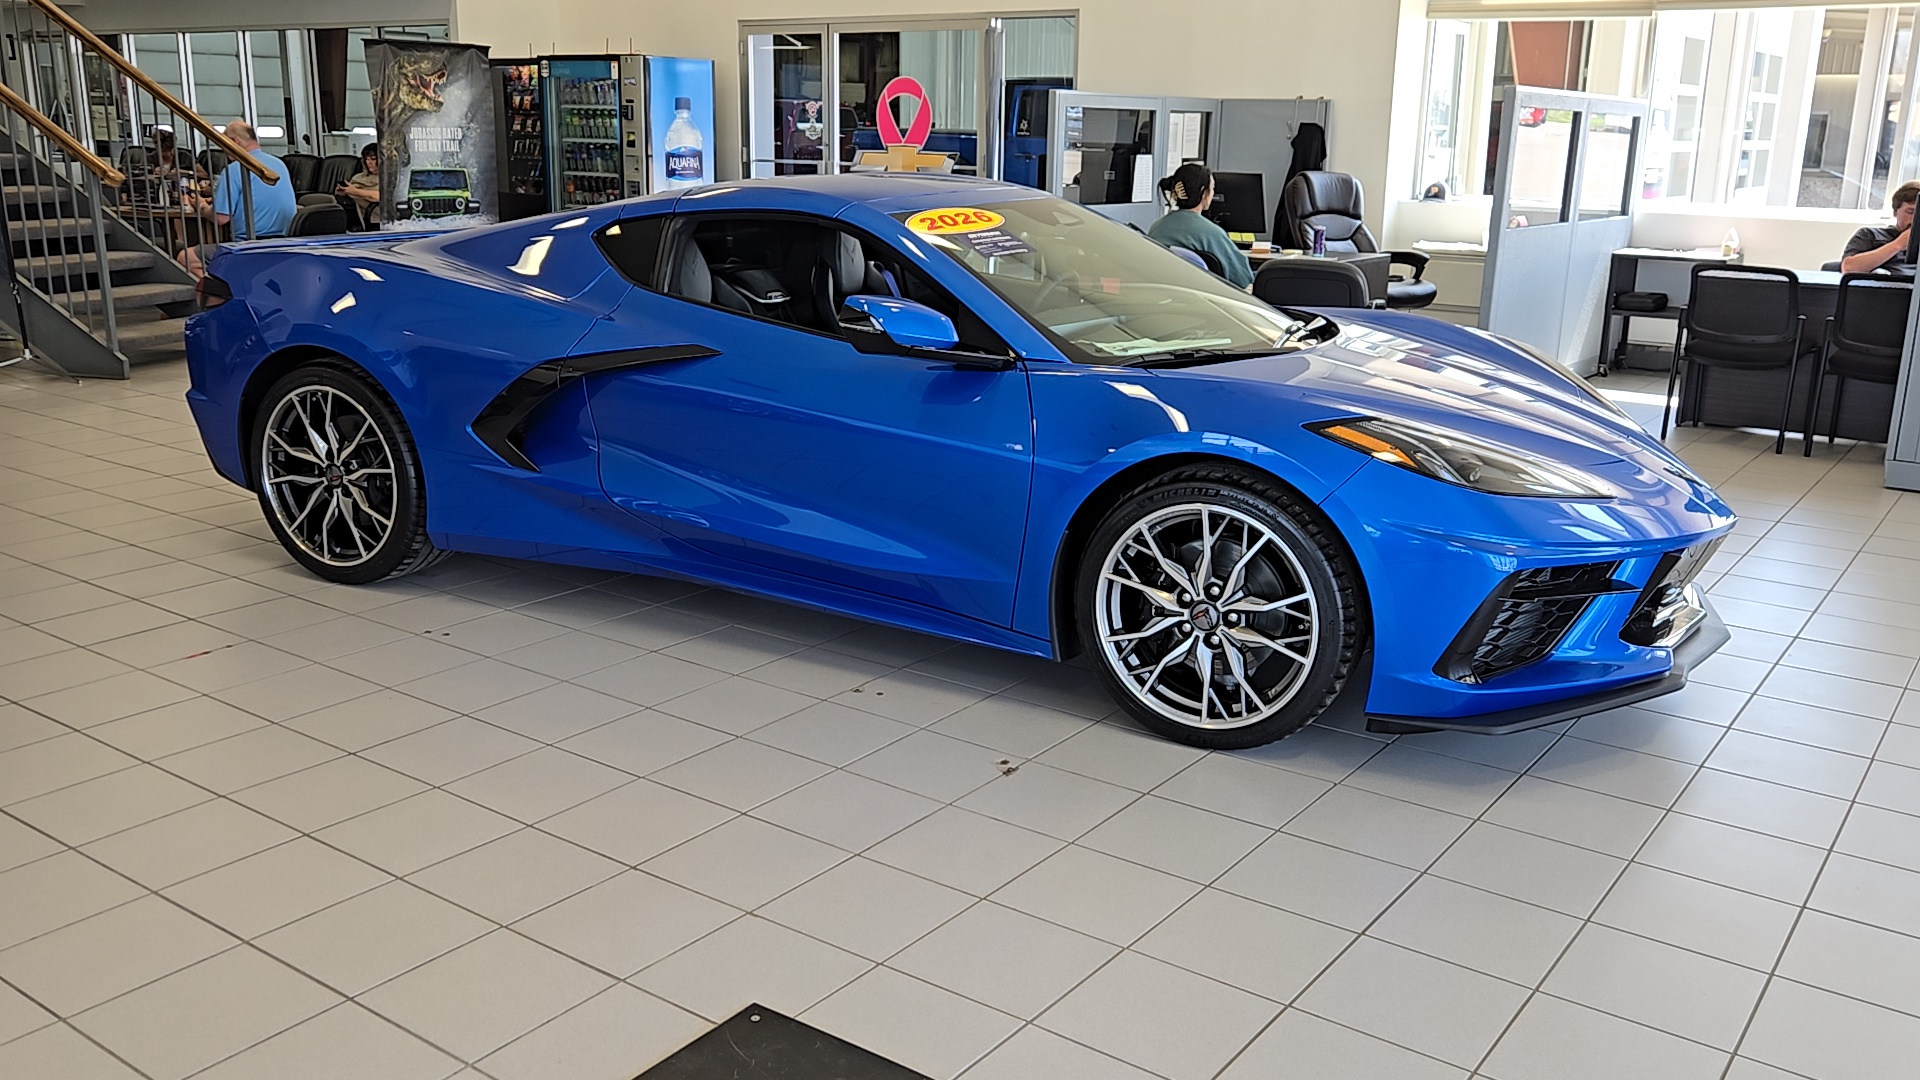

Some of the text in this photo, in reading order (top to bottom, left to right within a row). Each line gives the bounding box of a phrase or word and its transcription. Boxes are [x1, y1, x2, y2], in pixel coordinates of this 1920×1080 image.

[410, 126, 462, 139] JURASSIC RATED
[415, 140, 460, 152] FOR ANY TRAIL
[669, 156, 700, 170] AQUAFINA
[919, 211, 993, 231] 2026
[1153, 487, 1216, 500] MICHELIN
